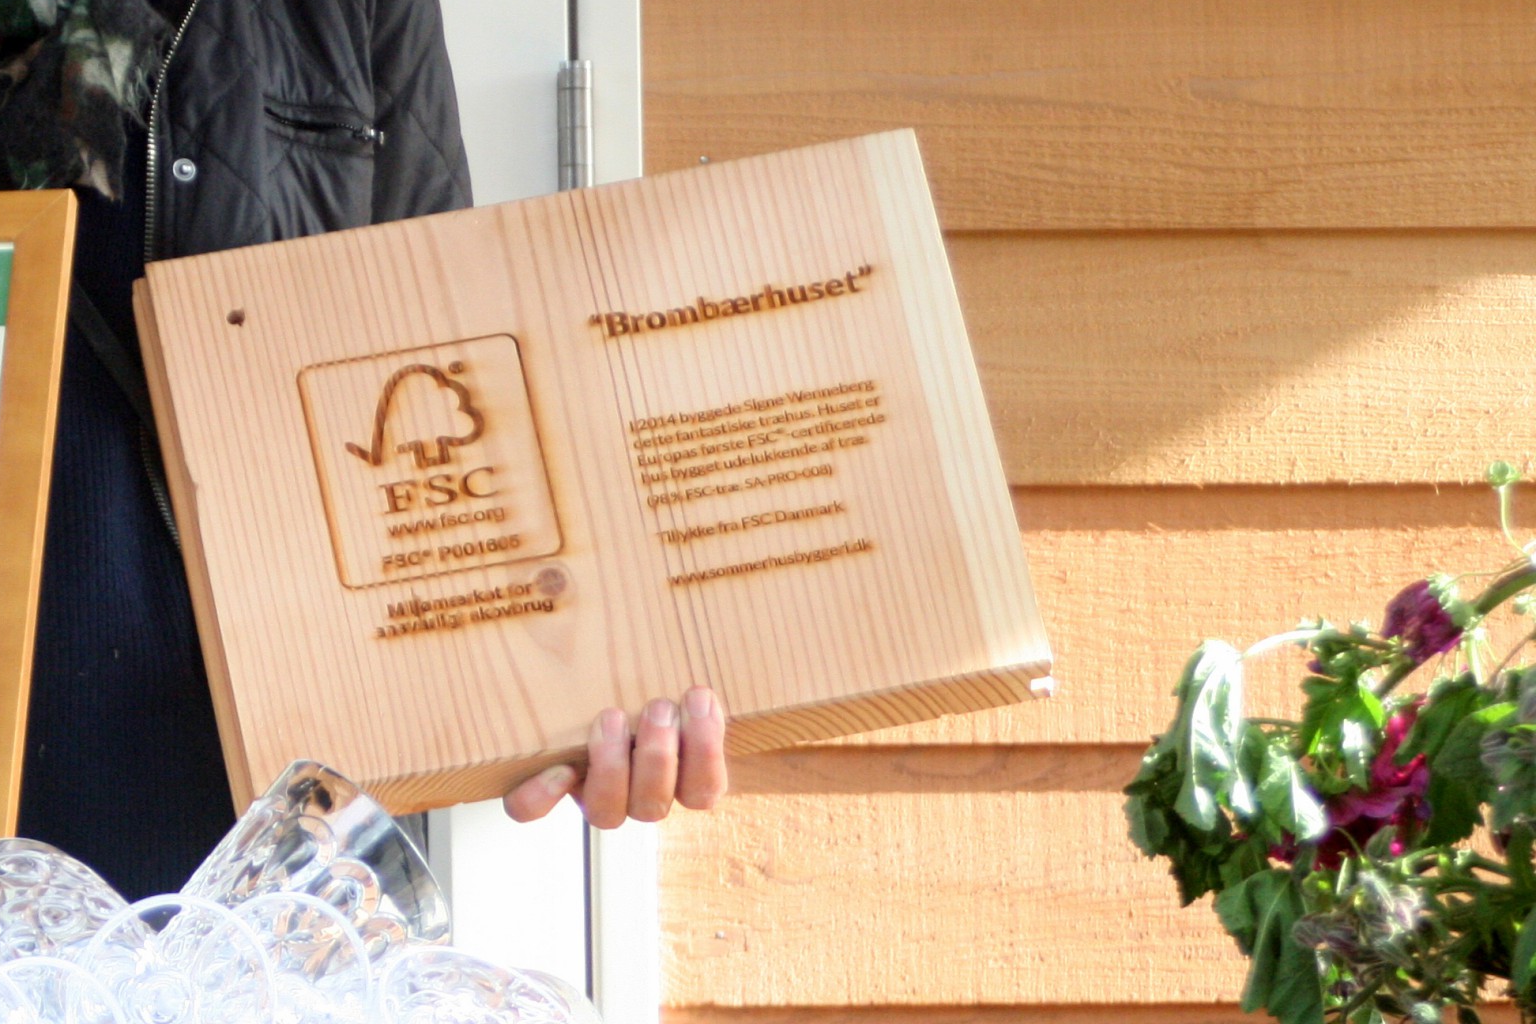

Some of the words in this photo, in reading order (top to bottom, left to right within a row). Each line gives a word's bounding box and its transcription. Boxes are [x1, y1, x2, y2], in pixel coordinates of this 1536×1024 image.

[636, 412, 676, 430] 2014
[678, 401, 741, 424] byggede
[785, 377, 875, 405] Wenneberg
[675, 417, 755, 441] fantastiske
[816, 398, 861, 416] Huset
[863, 395, 880, 408] er
[636, 444, 698, 467] Europas
[700, 436, 744, 454] første
[669, 459, 720, 479] bygget
[722, 442, 817, 468] udelukkende
[819, 438, 835, 451] af
[379, 467, 499, 514] FSC
[388, 507, 505, 537] www.fsc.org
[716, 518, 738, 533] fra
[740, 512, 772, 529] FSC
[773, 500, 844, 523] Danmark
